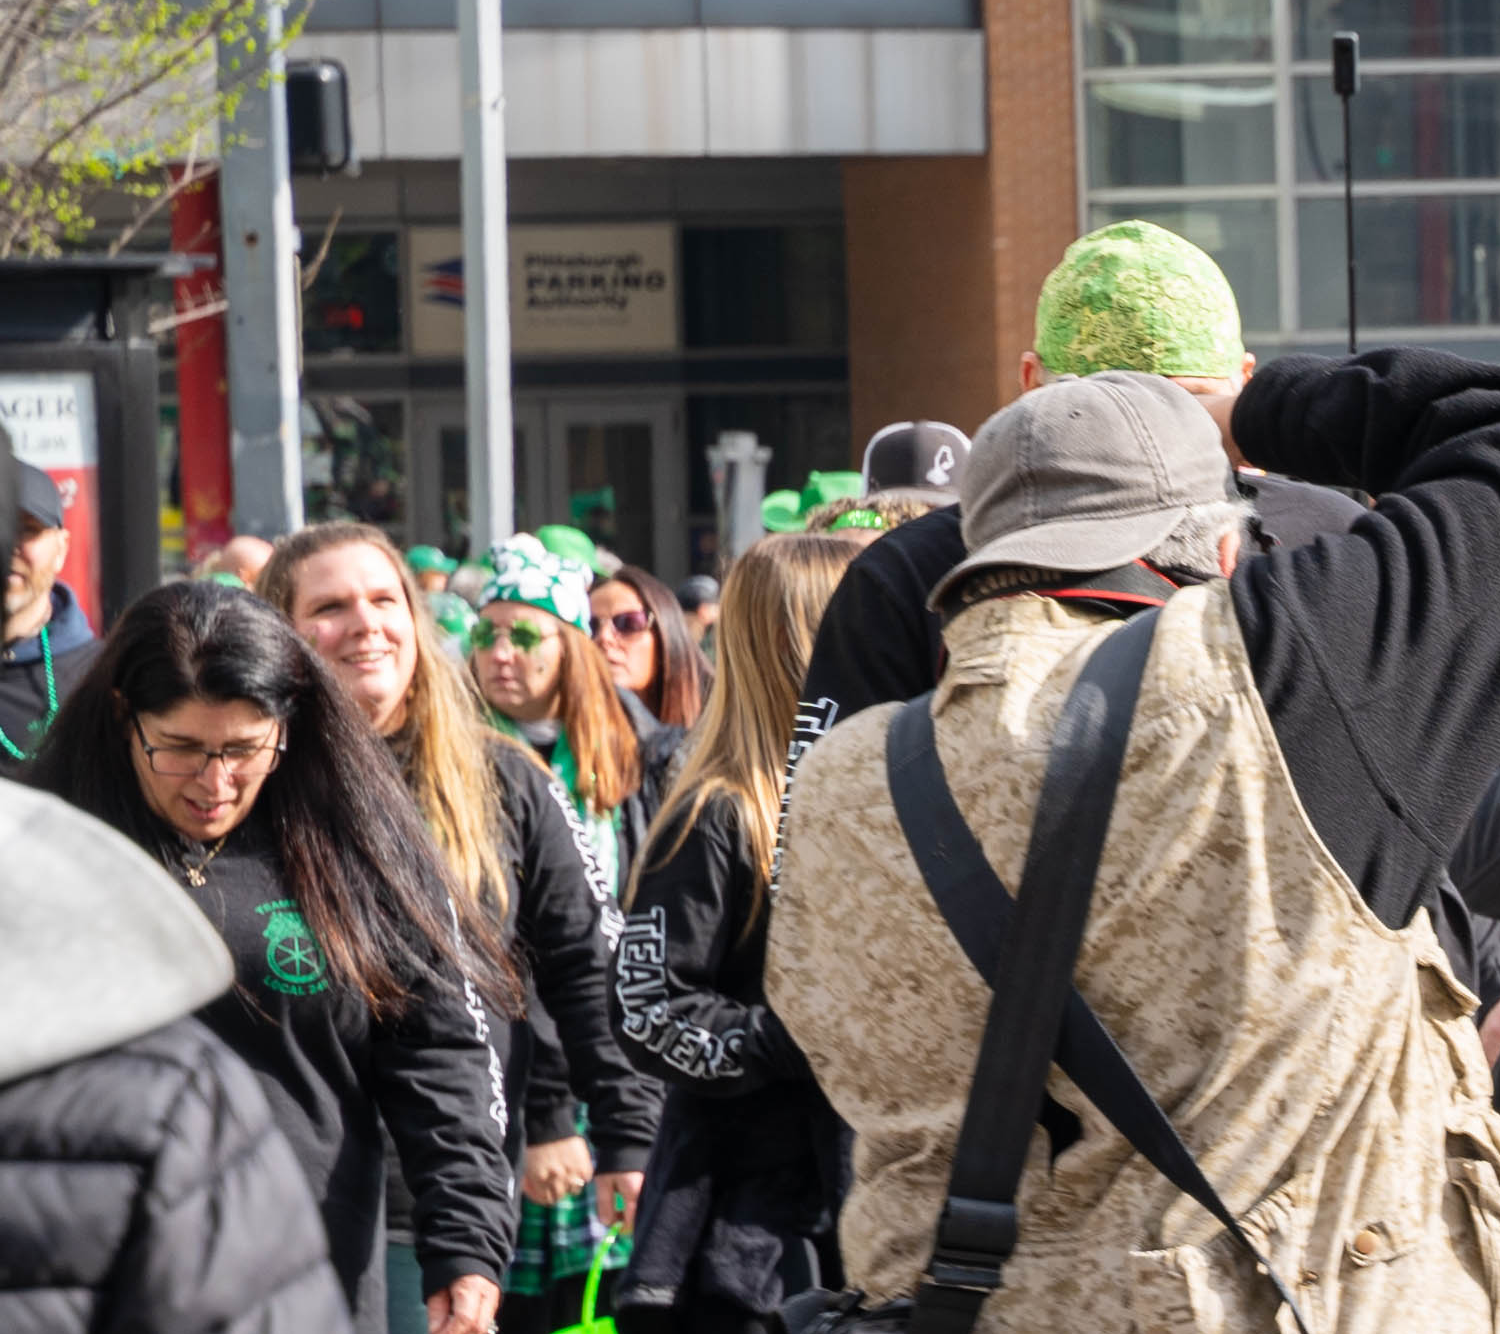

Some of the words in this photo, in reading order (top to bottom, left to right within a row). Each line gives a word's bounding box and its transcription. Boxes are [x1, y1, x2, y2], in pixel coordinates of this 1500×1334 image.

[527, 271, 665, 292] PARKING
[528, 294, 628, 312] Authority
[264, 975, 305, 996] LOCAL
